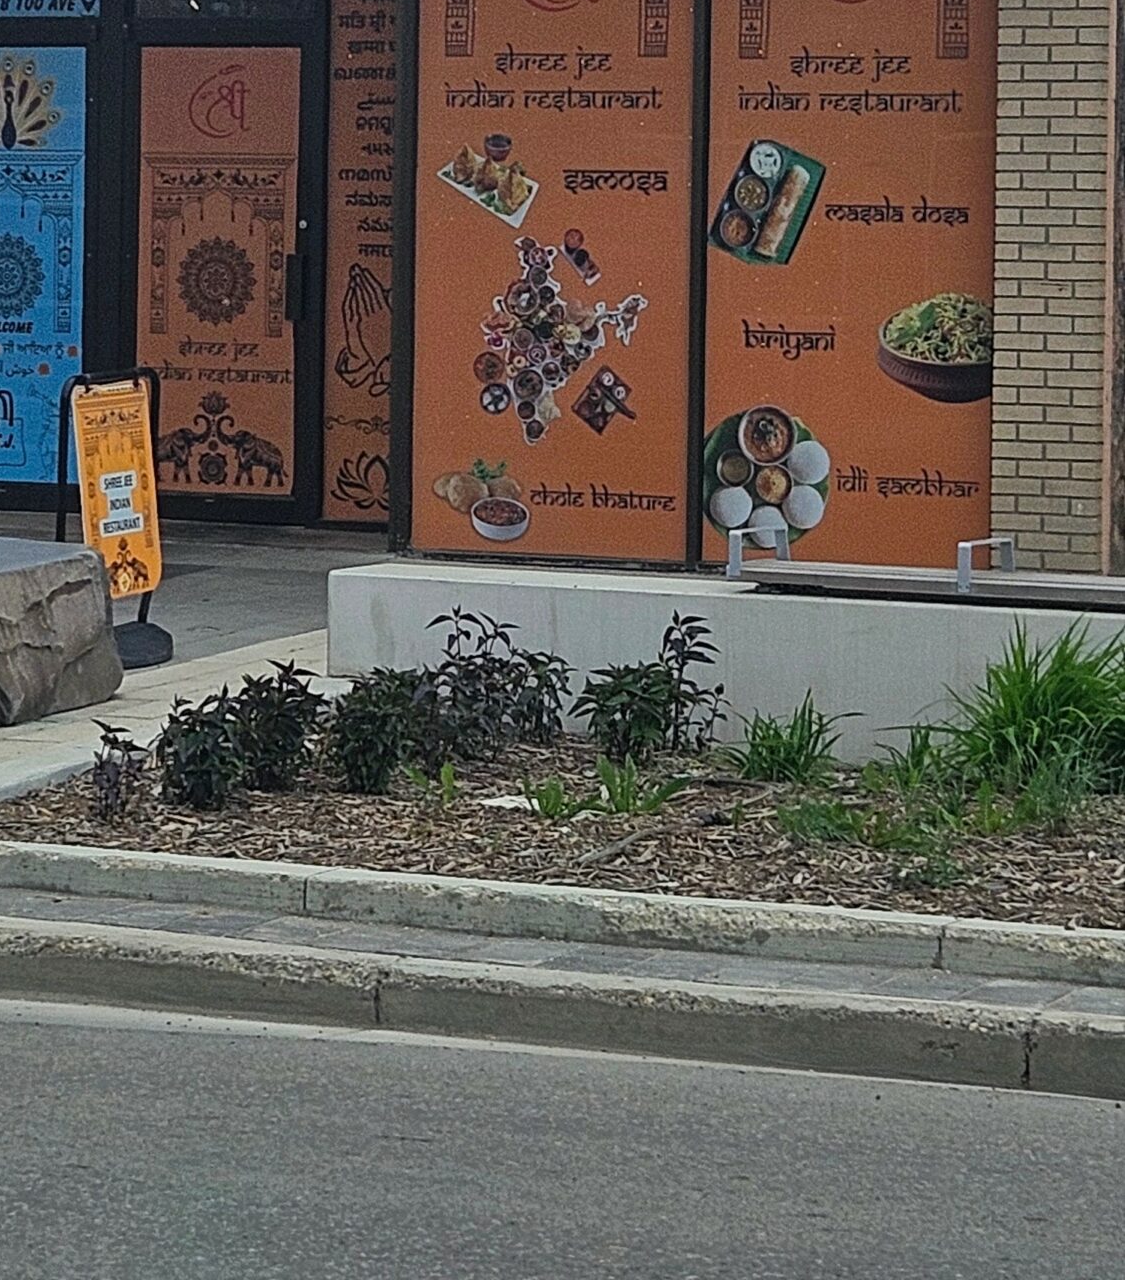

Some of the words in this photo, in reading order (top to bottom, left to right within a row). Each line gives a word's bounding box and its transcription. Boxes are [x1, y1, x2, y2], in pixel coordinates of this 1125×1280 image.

[494, 43, 567, 74] shree
[574, 46, 612, 80] jee
[790, 46, 864, 77] shree
[872, 50, 911, 81] jee
[445, 81, 514, 109] indian
[524, 88, 663, 112] restaurant
[738, 83, 811, 112] indian
[819, 91, 962, 116] restaurant
[562, 168, 669, 195] samosa
[825, 196, 904, 225] masala
[910, 195, 970, 226] dosa
[743, 322, 836, 360] biriyani
[103, 475, 122, 490] SHREE
[529, 482, 584, 508] chole
[592, 483, 676, 512] bhature
[834, 468, 869, 494] idli
[876, 471, 980, 499] sambhar
[110, 497, 131, 511] INDIAN
[102, 517, 141, 534] RESTAURANT
